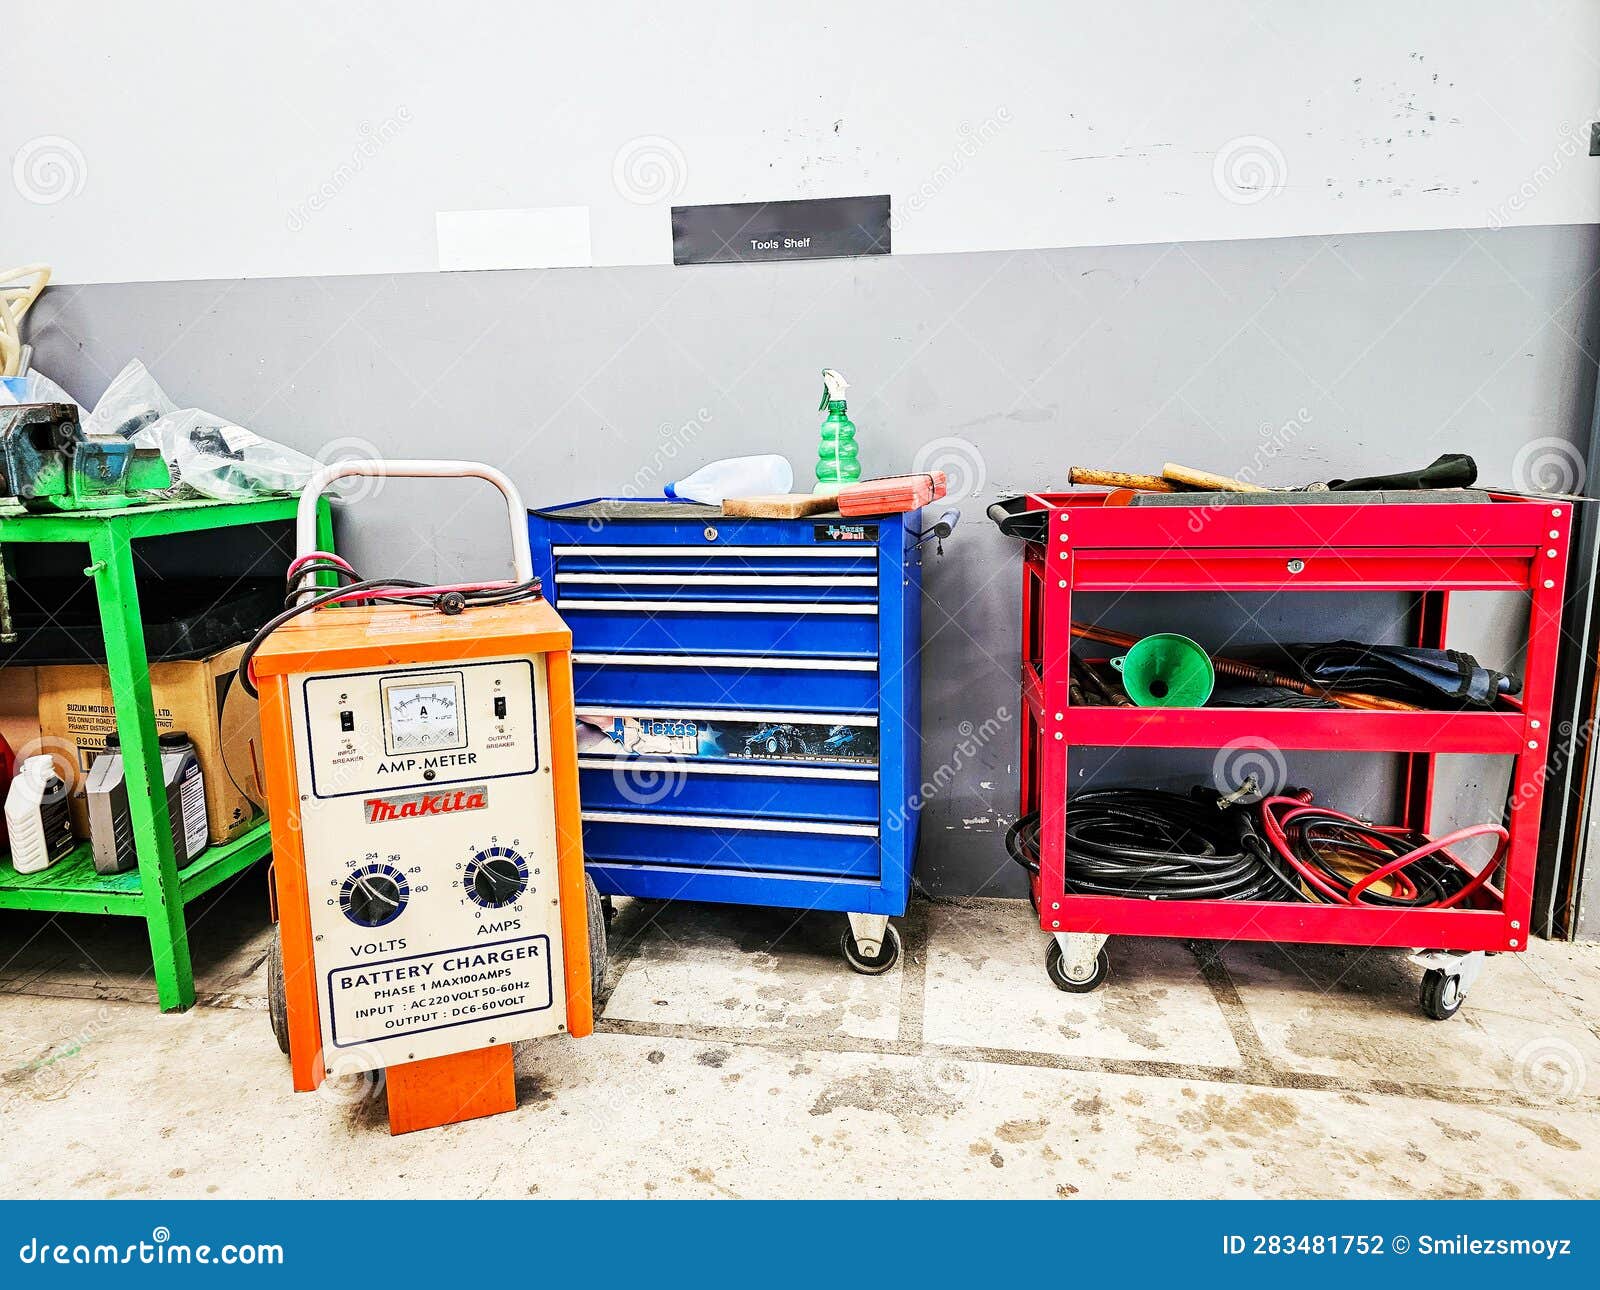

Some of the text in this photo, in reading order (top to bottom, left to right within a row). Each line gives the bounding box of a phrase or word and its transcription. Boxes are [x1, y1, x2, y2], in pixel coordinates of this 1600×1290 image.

[750, 237, 811, 250] Tools Shelf
[67, 703, 88, 712] SUZUKI
[88, 705, 109, 714] MOTOR
[158, 708, 172, 717] LTD.
[420, 705, 428, 716] A
[638, 717, 698, 737] Texas
[377, 752, 477, 775] AMP.METER
[512, 839, 520, 847] 6
[469, 844, 475, 852] 4
[366, 852, 379, 861] 24
[388, 853, 401, 862] 36
[527, 851, 534, 859] 7
[346, 860, 357, 868] 12
[456, 862, 462, 870] 3
[408, 866, 421, 874] 48
[452, 880, 459, 888] 2
[415, 885, 429, 893] 60
[530, 886, 537, 894] 9
[460, 898, 465, 906] 1
[513, 903, 523, 913] 10
[475, 911, 481, 919] 0
[476, 919, 522, 936] AMPS
[350, 938, 407, 957] VOLTS
[340, 945, 540, 990] BATTERY CHARGER
[374, 985, 416, 1000] PHASE
[420, 983, 426, 992] 1
[355, 1004, 395, 1019] INPUT
[385, 1011, 439, 1029] OUTPUT
